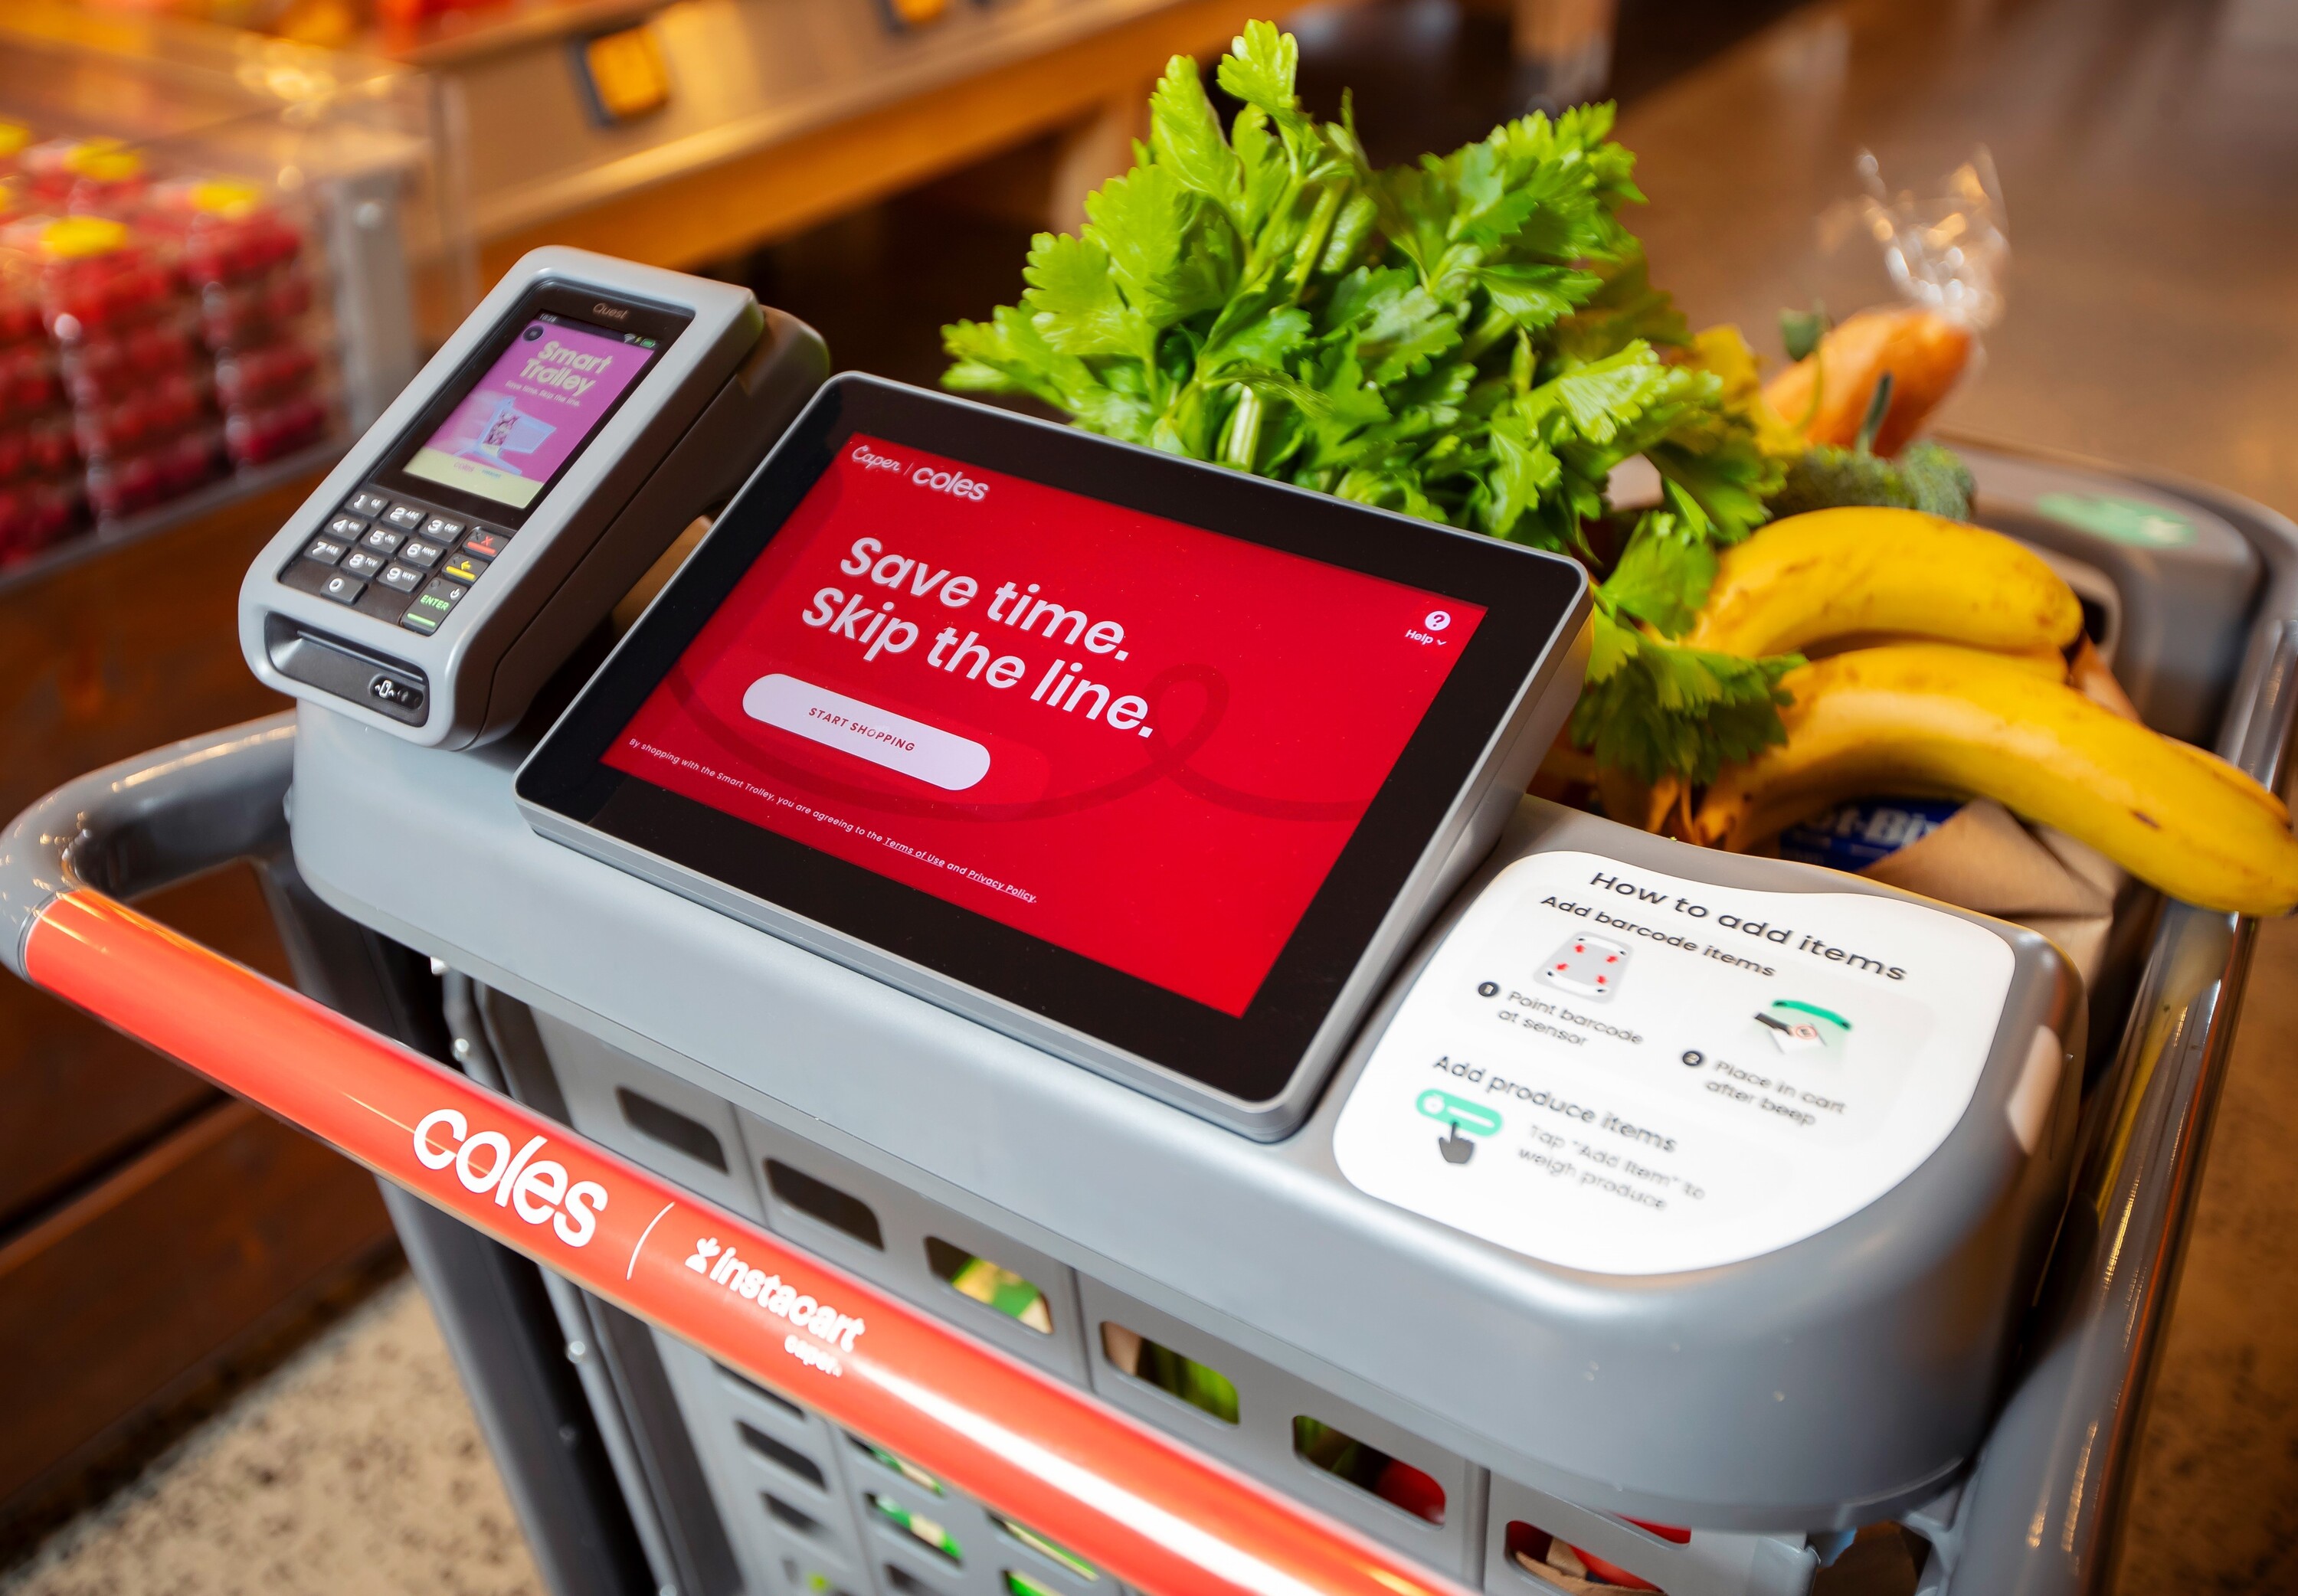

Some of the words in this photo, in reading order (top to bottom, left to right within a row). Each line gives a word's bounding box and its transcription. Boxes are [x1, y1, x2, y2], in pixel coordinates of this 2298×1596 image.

[593, 303, 629, 320] Quest
[538, 340, 613, 375] Smart
[519, 358, 597, 397] Trolley
[852, 445, 900, 469] Caper
[912, 467, 989, 500] coles
[354, 495, 368, 509] 1
[389, 507, 407, 522] 2
[405, 510, 421, 521] ABC
[332, 519, 348, 533] 4
[369, 530, 385, 545] 5
[427, 519, 444, 534] 3
[444, 523, 460, 534] DEF
[312, 541, 328, 555] 7
[349, 553, 366, 568] 8
[365, 557, 378, 567] TUV
[406, 543, 422, 558] 6
[421, 545, 437, 558] MNO
[329, 577, 345, 593] 0
[386, 567, 402, 582] 9
[420, 594, 450, 611] ENTER
[840, 536, 978, 608] Save
[987, 581, 1130, 662] time.
[1405, 629, 1434, 646] Help
[802, 587, 919, 662] Skip
[928, 626, 1026, 688] the
[1030, 659, 1154, 738] line.
[808, 707, 848, 728] START
[849, 721, 915, 752] SHOPPING
[629, 738, 640, 749] By
[641, 744, 680, 764] shopping
[681, 759, 699, 770] with
[701, 766, 715, 777] the
[717, 772, 744, 788] Smart
[745, 783, 775, 802] Trolley,
[776, 796, 794, 808] you
[796, 804, 811, 814] are
[813, 810, 854, 832] agreeing
[855, 826, 866, 836] to
[867, 830, 882, 842] the
[884, 837, 914, 855] Terms
[915, 850, 927, 859] of
[927, 854, 945, 866] Use
[947, 862, 967, 875] and
[967, 869, 1004, 891] Privacy
[1005, 885, 1037, 904] Policy.
[1540, 895, 1592, 917] Add
[1596, 911, 1699, 952] barcode
[1703, 944, 1778, 977] items
[1589, 872, 1669, 905] How
[1674, 898, 1709, 919] to
[1718, 914, 1795, 945] add
[1798, 935, 1909, 982] items
[1498, 1010, 1519, 1022] at
[1523, 1018, 1589, 1047] sensor
[1507, 991, 1557, 1015] Point
[1560, 1009, 1644, 1044] barcode
[1433, 1055, 1487, 1084] Add
[1486, 1076, 1596, 1123] produce
[1600, 1111, 1678, 1153] items
[1706, 1081, 1756, 1104] after
[1760, 1097, 1816, 1127] beep
[1716, 1060, 1772, 1089] Place
[1776, 1081, 1796, 1097] in
[1802, 1092, 1847, 1114] cart
[413, 1108, 608, 1248] coles
[1519, 1148, 1576, 1177] weigh
[1580, 1172, 1667, 1210] produce
[1530, 1125, 1566, 1150] Tap
[1684, 1182, 1705, 1200] to
[710, 1246, 866, 1352] instacart
